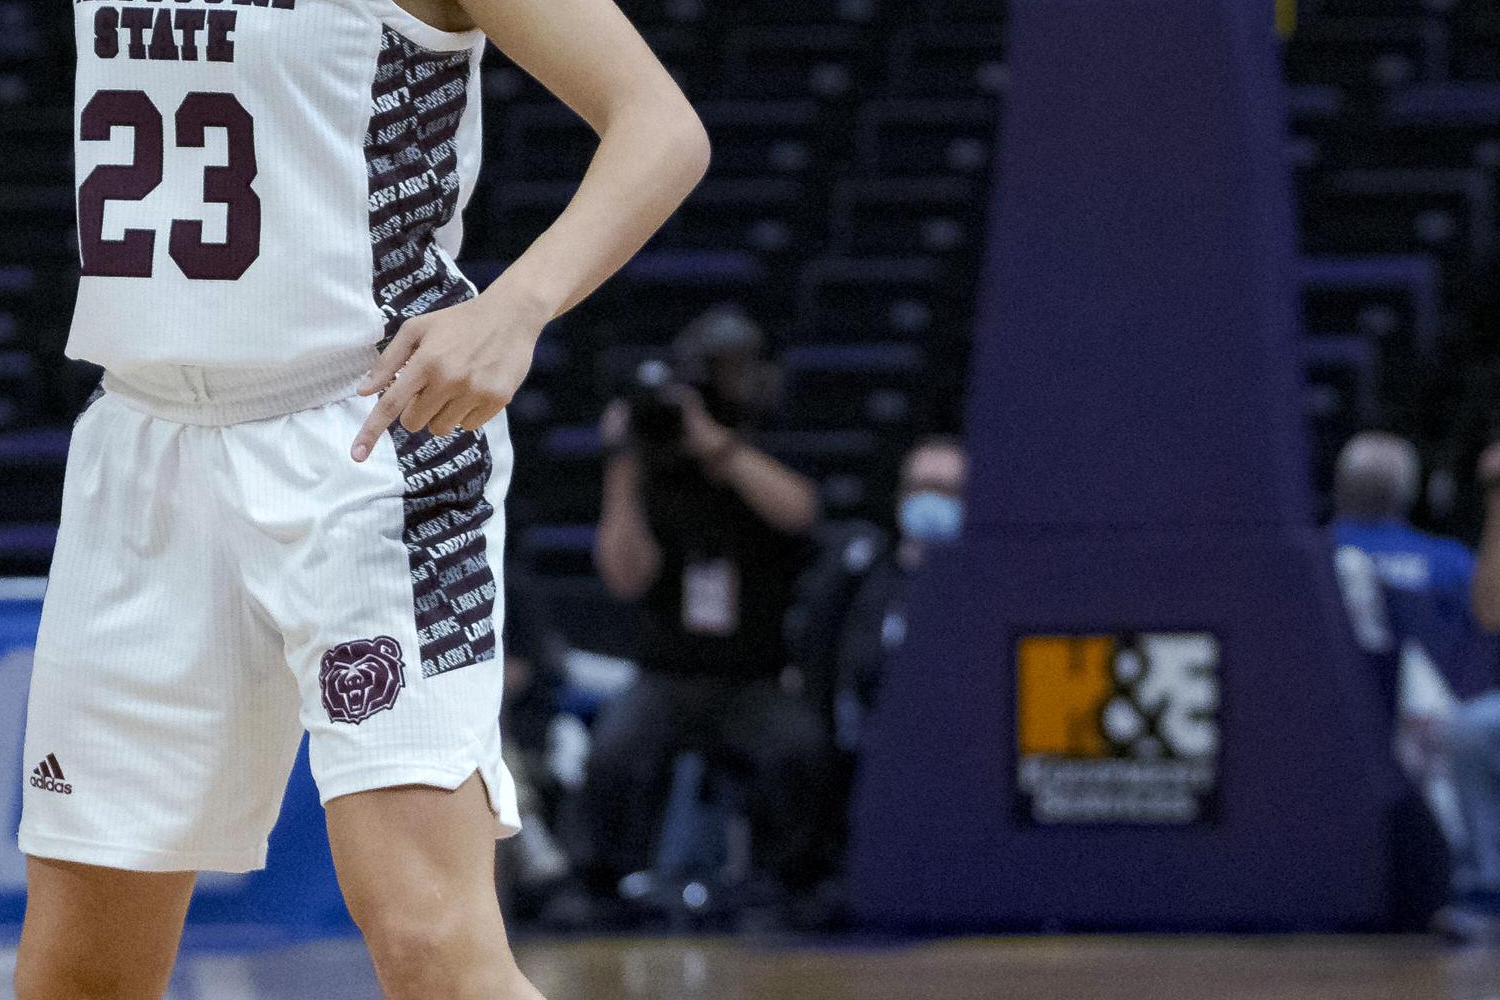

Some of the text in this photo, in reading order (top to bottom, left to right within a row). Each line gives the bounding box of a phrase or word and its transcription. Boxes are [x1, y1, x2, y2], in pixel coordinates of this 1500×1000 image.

[93, 6, 238, 63] STATE
[78, 89, 262, 281] 23
[30, 775, 73, 795] adidas
